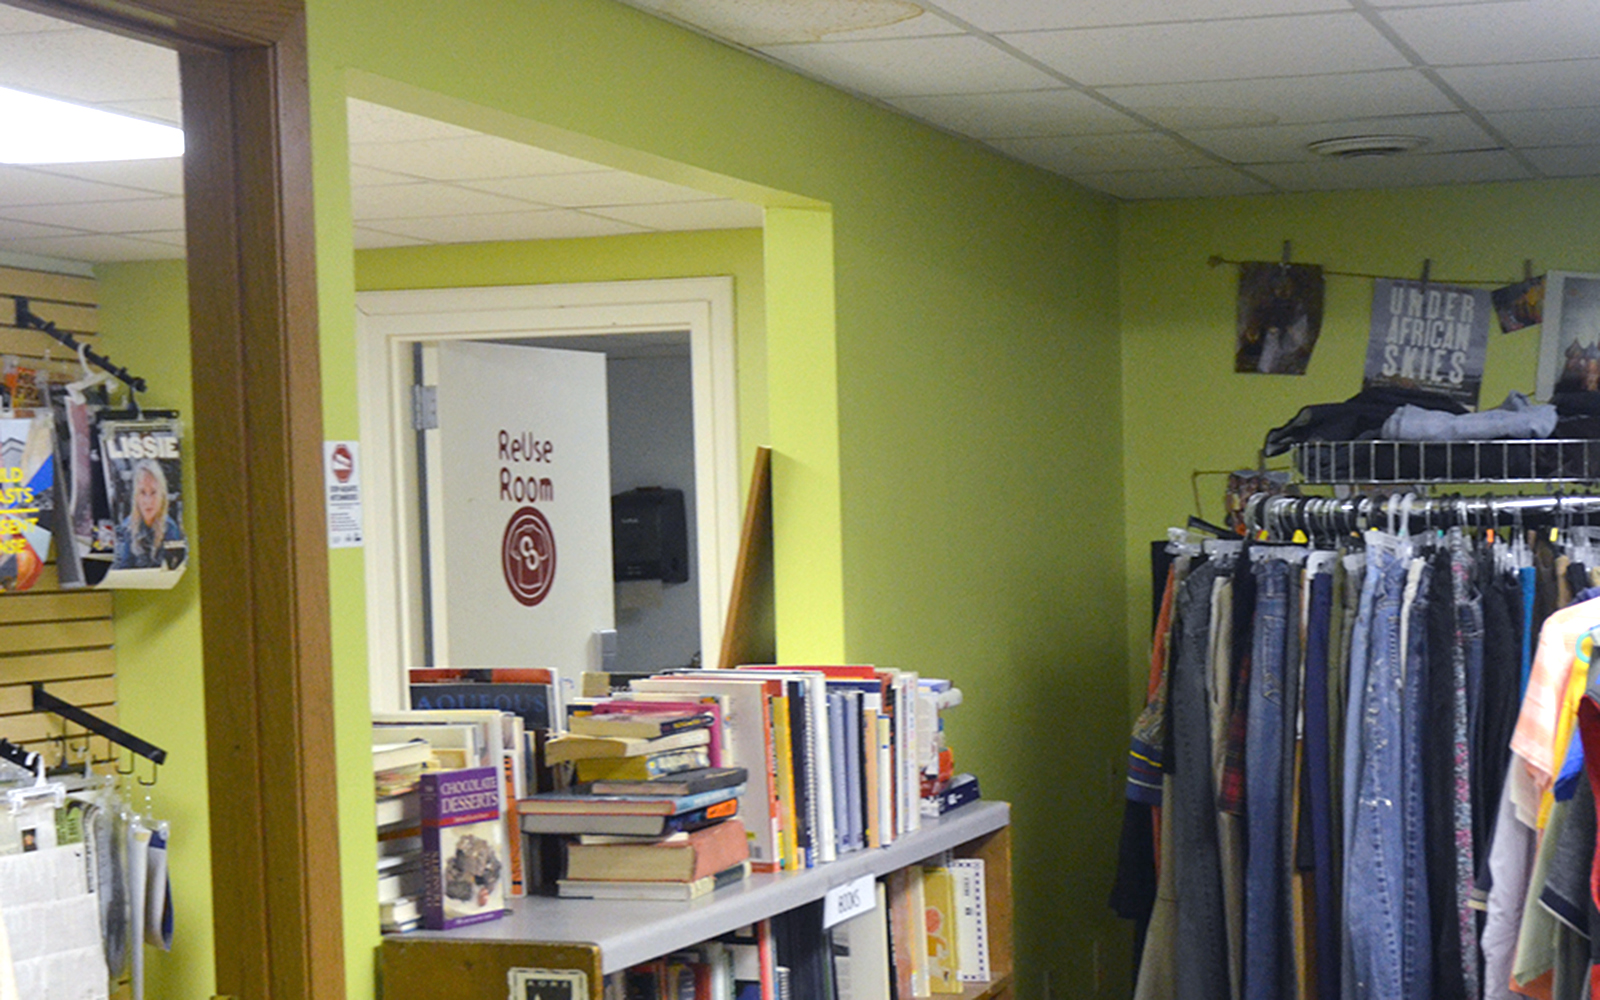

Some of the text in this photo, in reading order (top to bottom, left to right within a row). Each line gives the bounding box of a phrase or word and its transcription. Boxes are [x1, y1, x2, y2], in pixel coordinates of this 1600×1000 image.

[1390, 287, 1475, 322] UNDER
[1385, 316, 1471, 351] AFRICAN
[1382, 344, 1466, 384] SKIES
[106, 435, 179, 459] LISSIE
[498, 429, 553, 463] ReUse
[499, 467, 554, 503] Room
[440, 776, 498, 795] CHOCOLATE
[441, 790, 499, 814] DESSERTS
[838, 889, 861, 914] BOOKS
